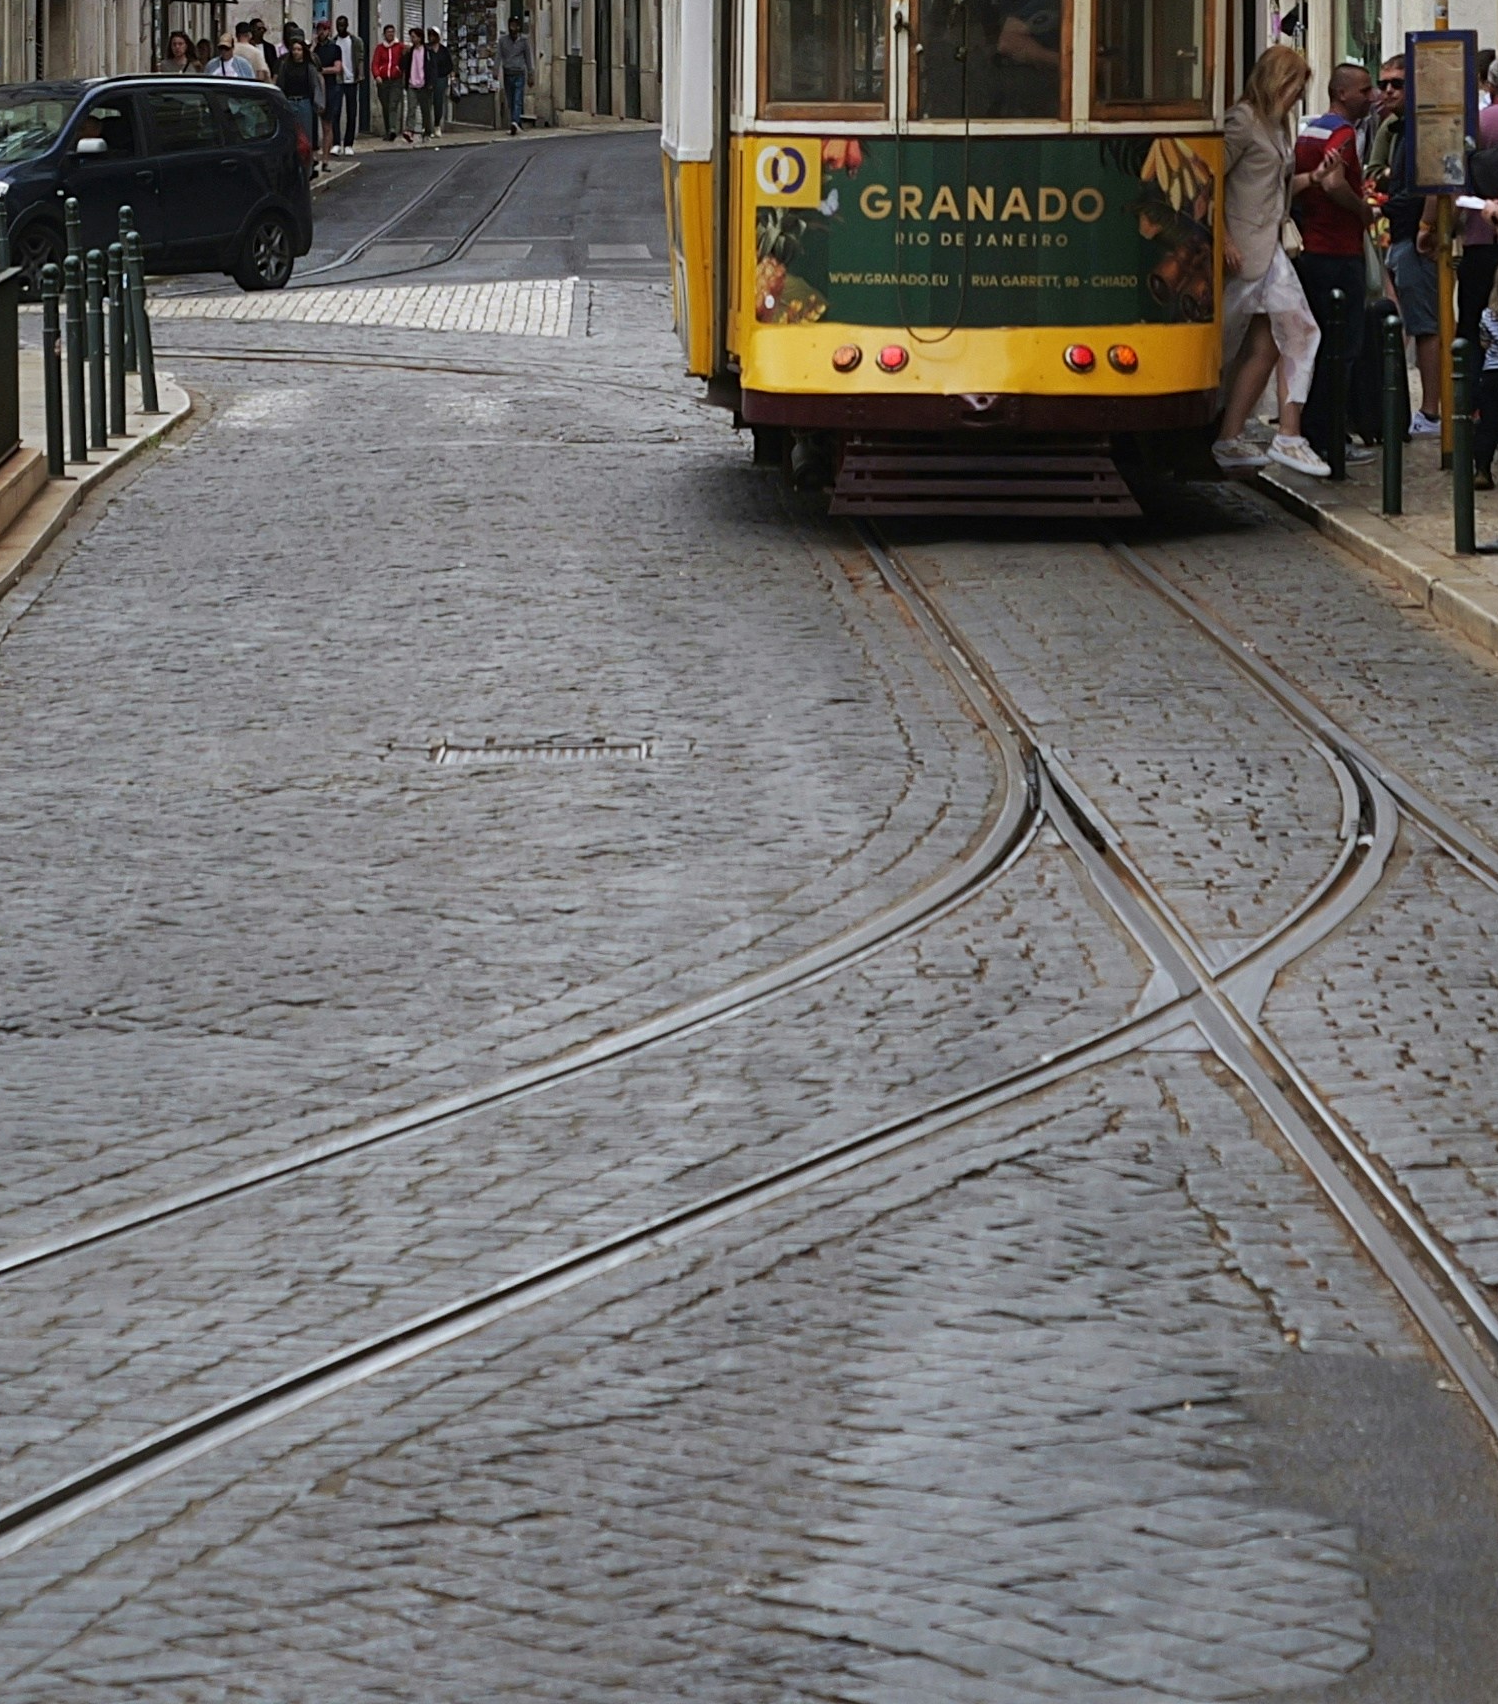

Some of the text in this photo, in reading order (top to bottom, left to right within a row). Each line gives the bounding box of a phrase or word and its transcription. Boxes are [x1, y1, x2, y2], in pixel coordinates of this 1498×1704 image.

[859, 184, 1105, 223] GRANADO
[895, 232, 1069, 247] RIO DE JANEIRO
[829, 272, 949, 287] WWW.GRANADO.EU
[971, 275, 998, 287] RUA
[1001, 275, 1061, 289] GARRETT,
[1091, 276, 1138, 288] CHIADO
